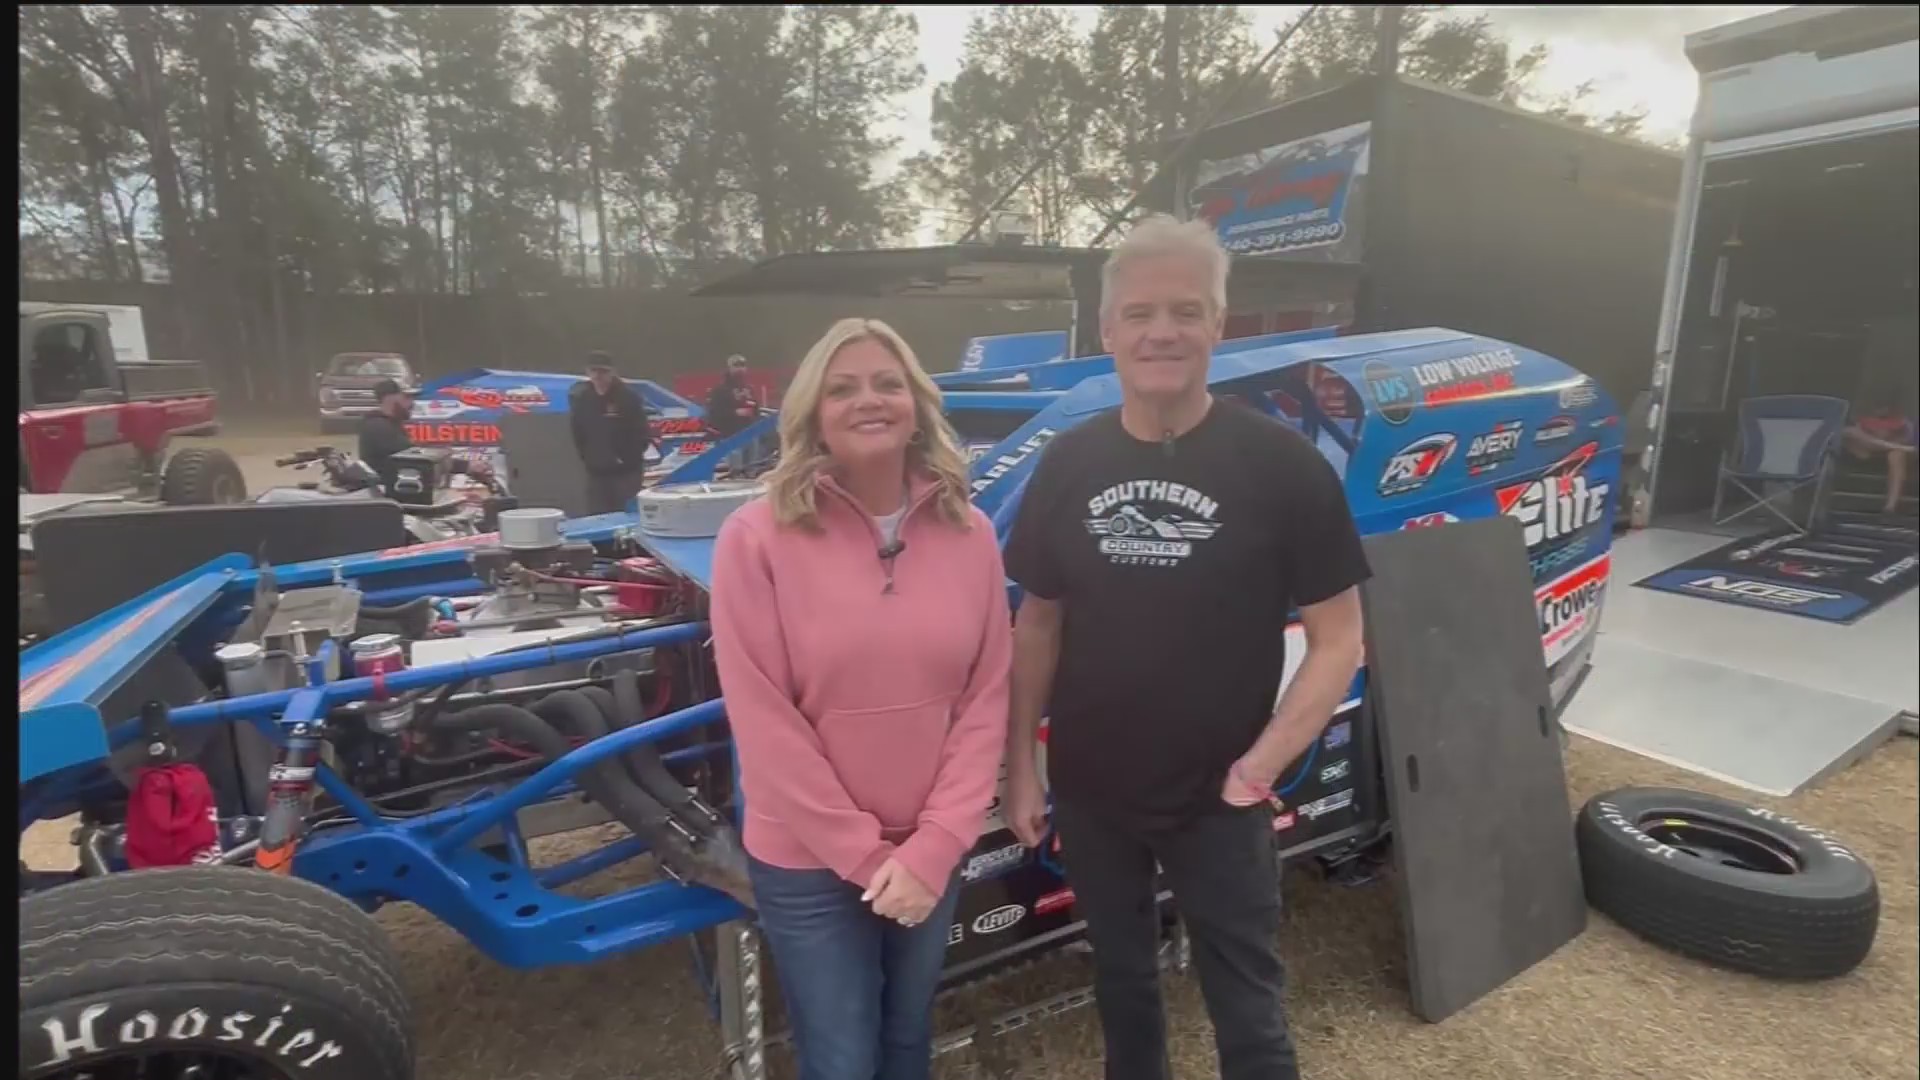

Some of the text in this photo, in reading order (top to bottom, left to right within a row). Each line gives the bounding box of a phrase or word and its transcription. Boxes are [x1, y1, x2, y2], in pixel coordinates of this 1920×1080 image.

[1413, 349, 1521, 386] LOW VOLTAGE
[1466, 429, 1525, 458] AVERY
[1087, 479, 1219, 518] SOUTHERN
[1107, 540, 1185, 554] COUNTRY
[1110, 555, 1180, 567] CUSTOMS
[28, 1002, 342, 1070] Hoosier
